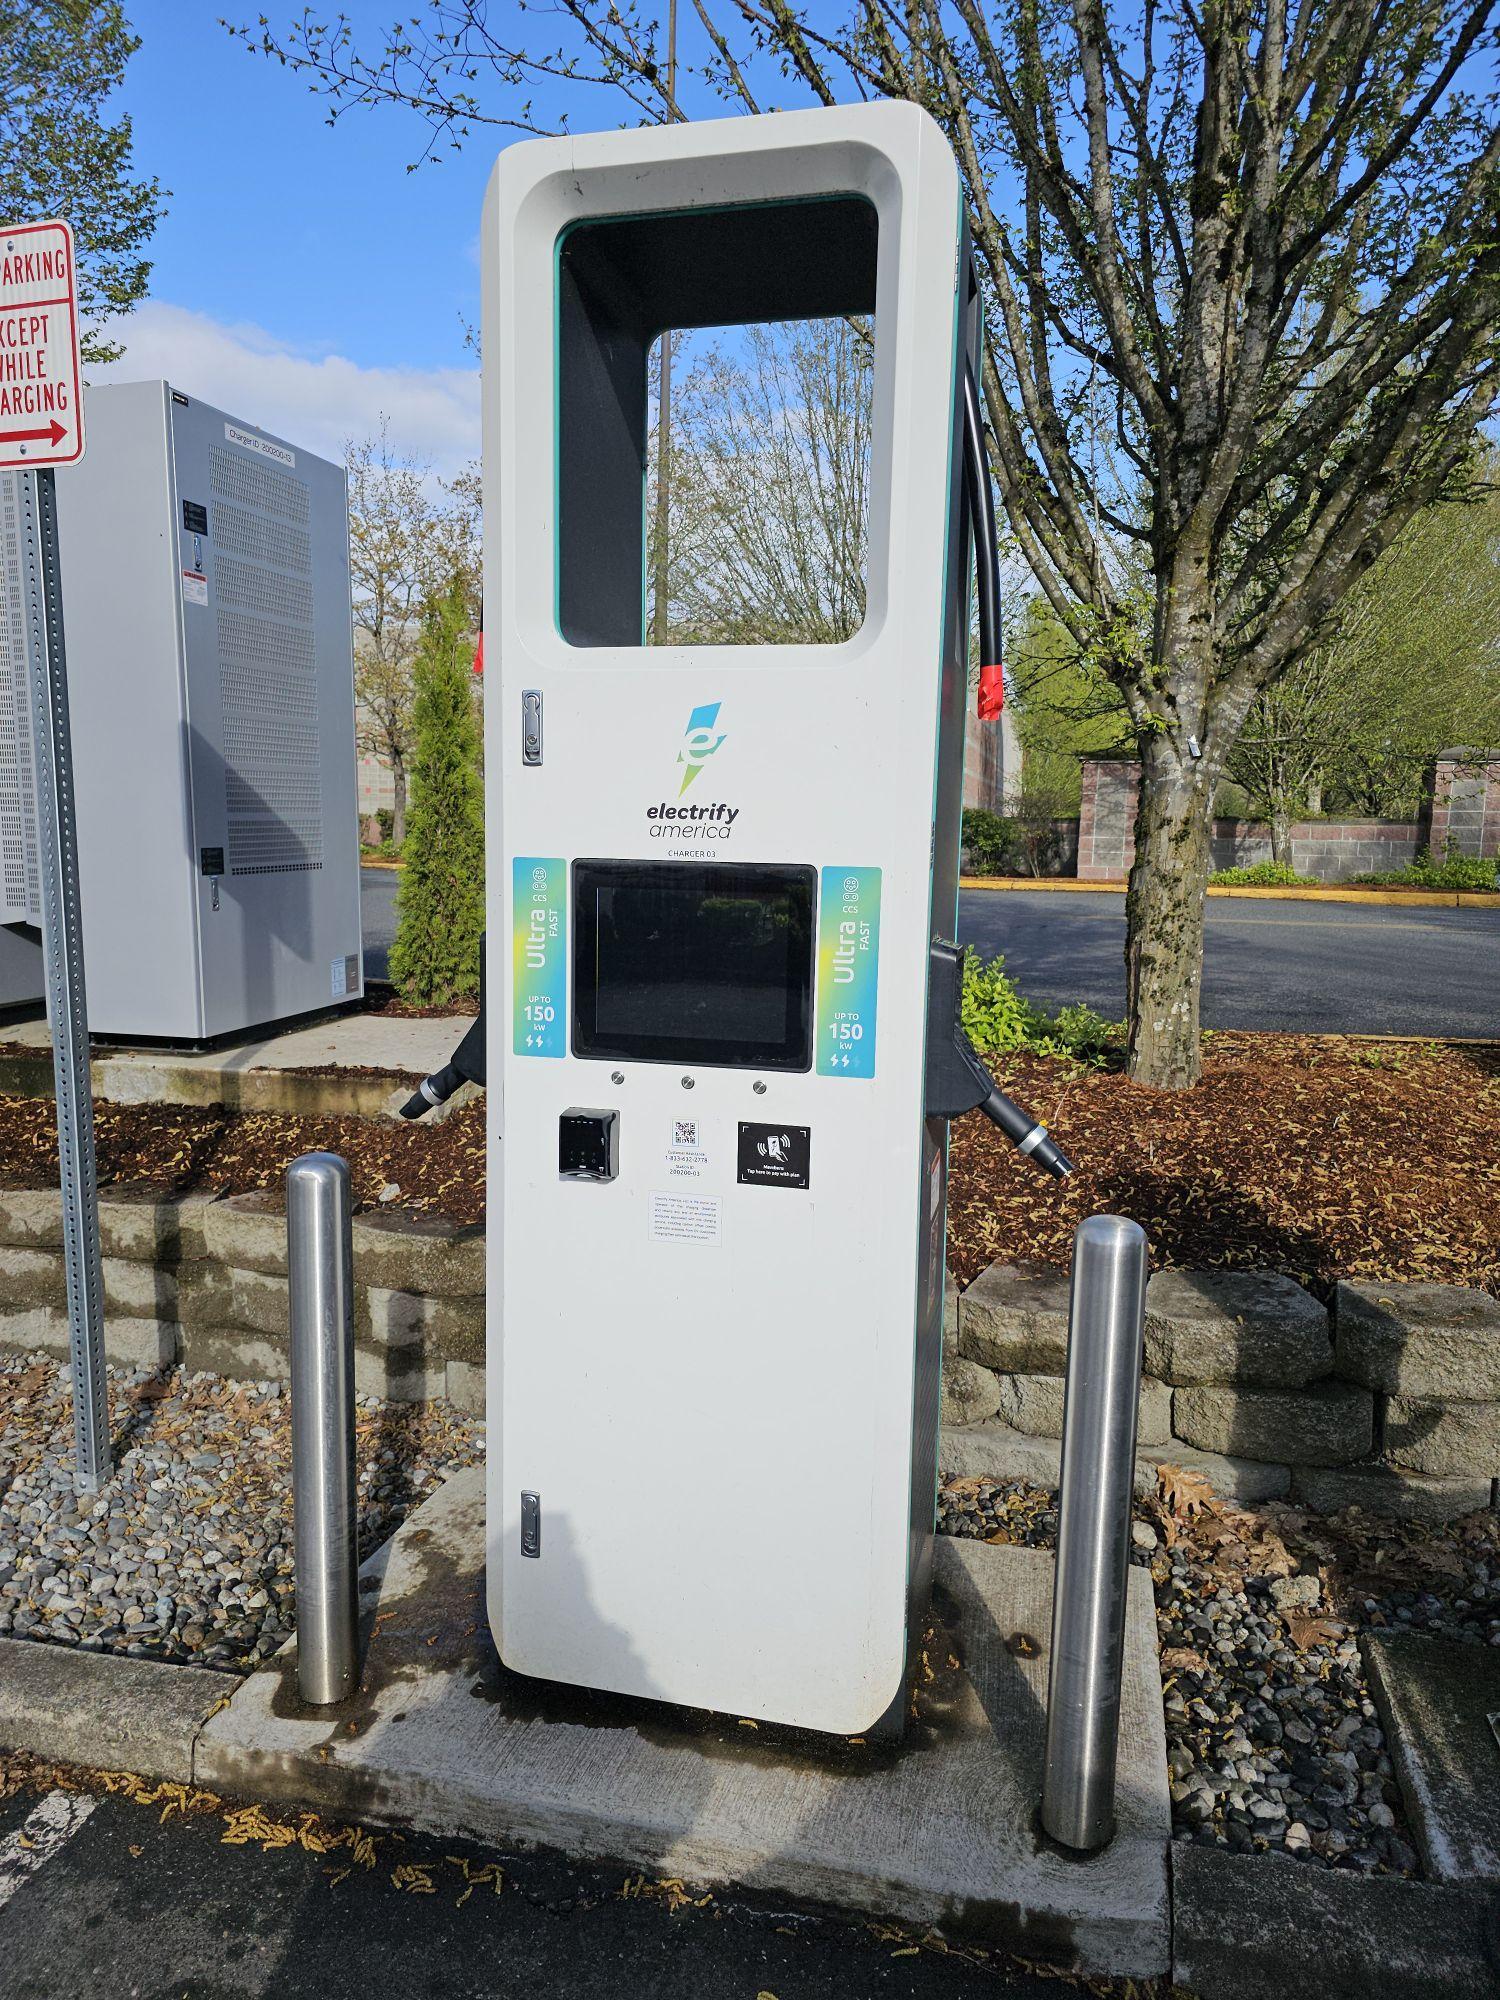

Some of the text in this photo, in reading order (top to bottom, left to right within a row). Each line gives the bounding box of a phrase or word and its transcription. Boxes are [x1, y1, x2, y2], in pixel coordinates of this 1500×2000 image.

[0, 249, 66, 286] ARKING
[0, 314, 49, 349] XCEPT
[0, 350, 47, 382] HILE
[0, 381, 68, 416] ARGING
[646, 802, 740, 825] electrify
[649, 822, 732, 839] america
[667, 849, 716, 858] CHARGER 03
[532, 894, 548, 902] CCS
[842, 905, 858, 914] CCS
[549, 908, 558, 937] FAST
[525, 909, 546, 969] Ultra
[859, 920, 870, 951] FAST
[832, 921, 857, 984] Ultra
[528, 995, 551, 1004] UP TO
[524, 1005, 555, 1022] 150
[834, 1012, 860, 1021] UP TO
[533, 1023, 546, 1031] kW
[829, 1022, 863, 1041] 150
[839, 1041, 853, 1050] kW
